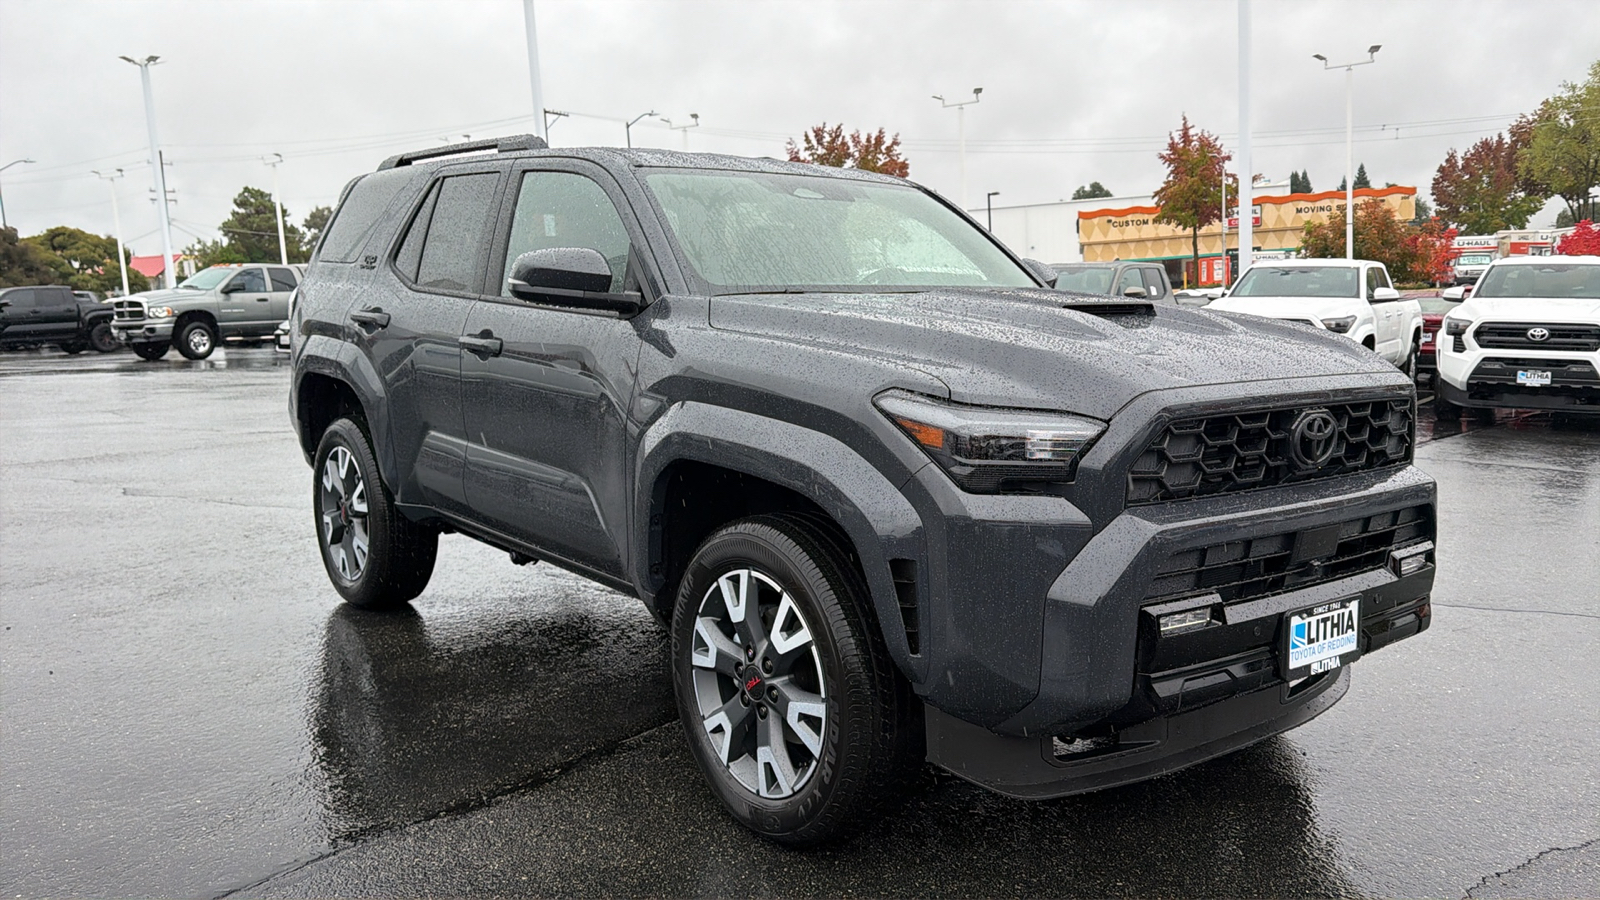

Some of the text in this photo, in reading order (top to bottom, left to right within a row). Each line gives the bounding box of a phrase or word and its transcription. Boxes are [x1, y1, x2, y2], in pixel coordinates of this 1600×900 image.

[1296, 204, 1332, 214] MOVING
[1525, 372, 1550, 380] LITHIA
[1313, 604, 1329, 615] SINCE
[1307, 610, 1355, 645] LITHIA
[1291, 634, 1356, 662] TOYOTA OF REDDING
[1317, 656, 1340, 673] LITHIA
